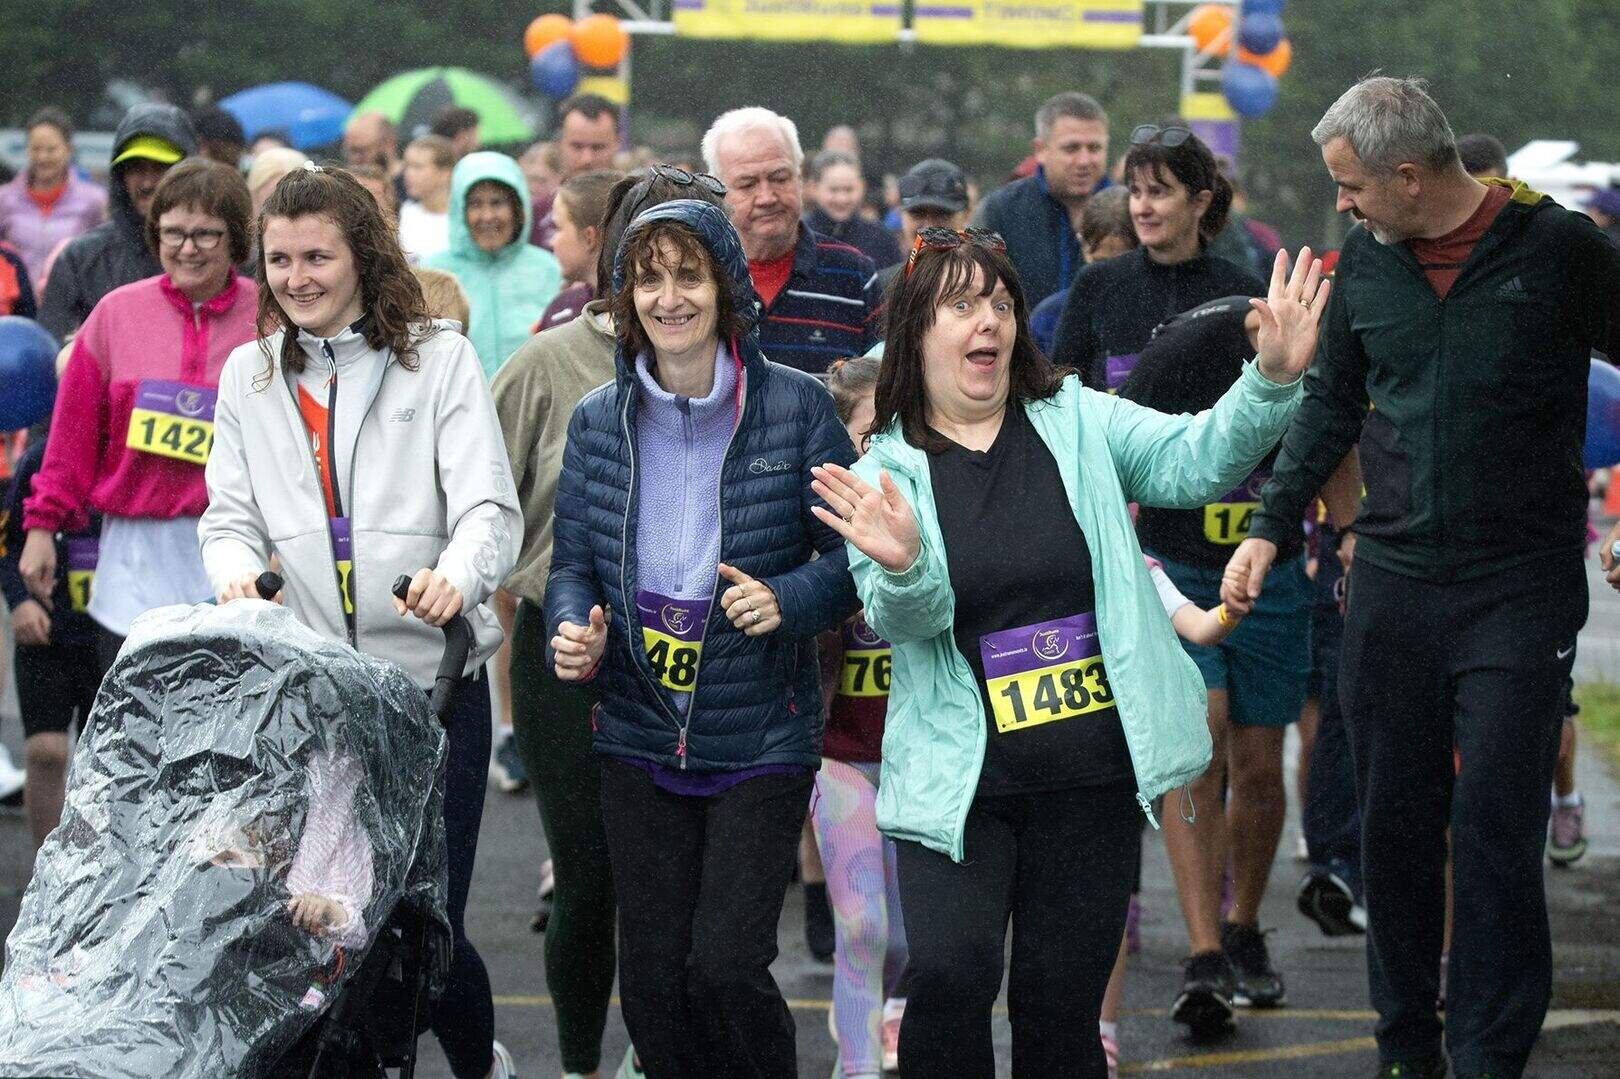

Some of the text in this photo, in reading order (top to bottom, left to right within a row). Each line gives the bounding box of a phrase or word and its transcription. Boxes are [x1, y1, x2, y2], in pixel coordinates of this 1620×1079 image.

[141, 417, 214, 457] 142
[646, 639, 698, 687] 48
[846, 654, 892, 692] 76
[1001, 661, 1115, 723] 1483
